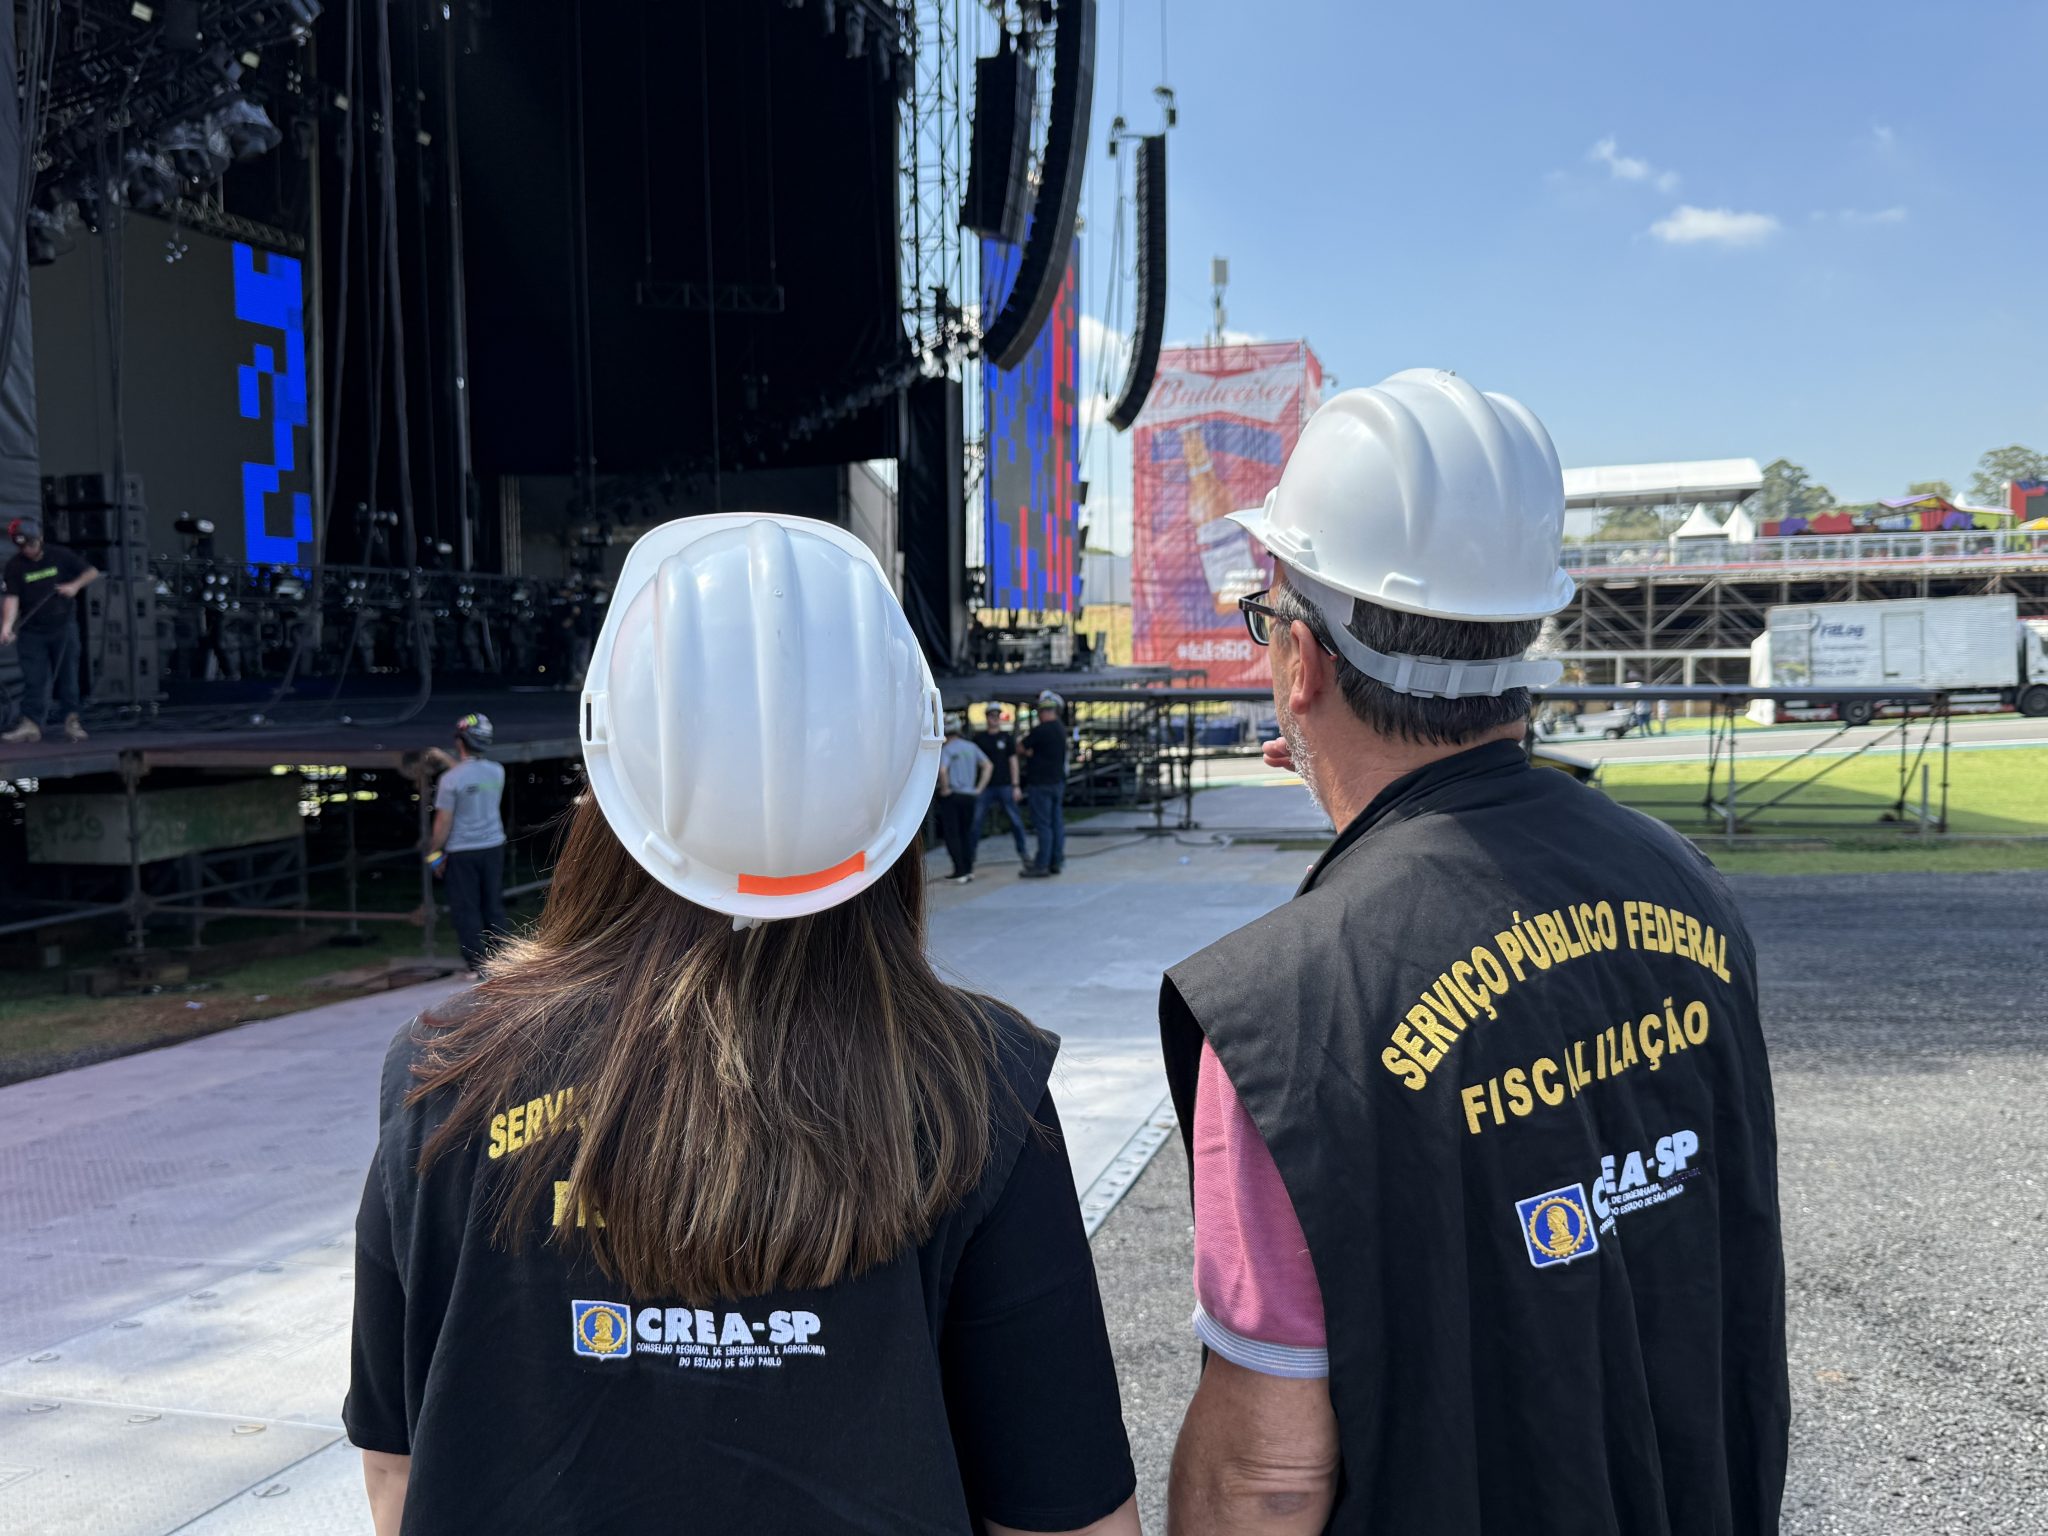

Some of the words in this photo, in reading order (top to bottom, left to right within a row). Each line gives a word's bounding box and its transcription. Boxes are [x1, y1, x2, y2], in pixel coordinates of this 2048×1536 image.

[1151, 376, 1296, 409] Budweiser
[1381, 945, 1510, 1091] SERVIÇO
[1495, 900, 1617, 982] PÚBLICO
[1623, 901, 1732, 984] FEDERAL
[1461, 997, 1710, 1134] FISCALIZAÇÃO
[488, 1087, 578, 1160] SERV
[1592, 1130, 1699, 1219] CEA-SP
[1620, 1199, 1644, 1214] ESTADO
[1653, 1191, 1667, 1203] SÃO
[635, 1307, 822, 1345] CREA-SP
[636, 1342, 673, 1355] CONSELHO
[676, 1344, 710, 1356] REGIONAL
[713, 1346, 723, 1356] DE
[725, 1345, 771, 1357] ENGENHARIA
[774, 1345, 780, 1356] E
[679, 1357, 691, 1368] DO
[693, 1358, 722, 1369] ESTADO
[725, 1358, 736, 1368] DE
[738, 1356, 756, 1368] SÃO
[758, 1357, 783, 1368] PAULO
